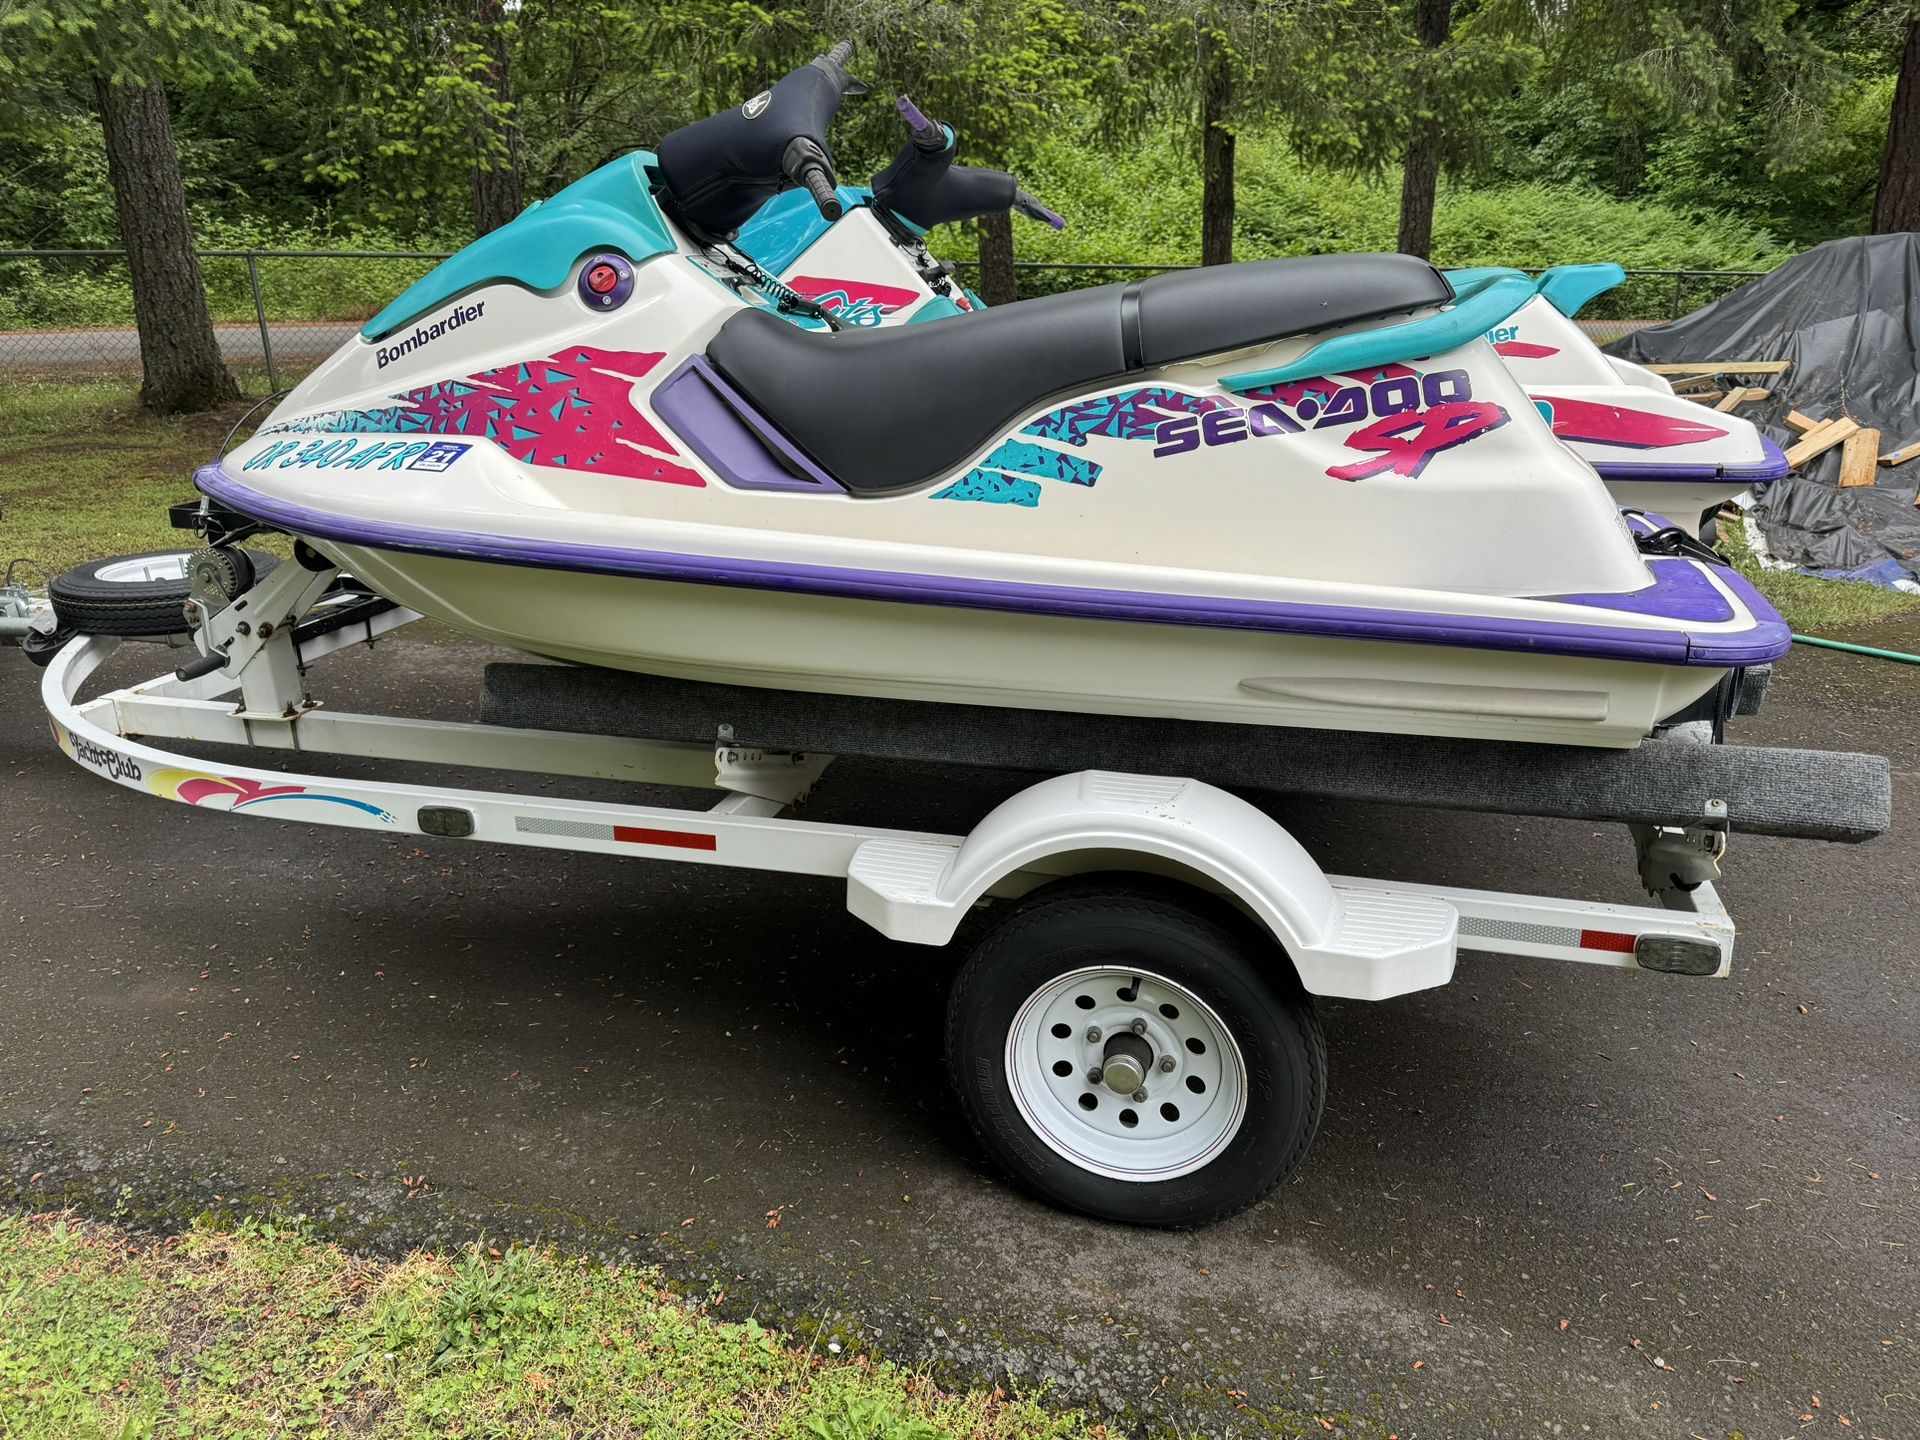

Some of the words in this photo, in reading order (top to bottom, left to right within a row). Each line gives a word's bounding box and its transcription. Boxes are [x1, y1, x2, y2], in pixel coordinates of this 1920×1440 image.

[376, 301, 485, 369] Bombardier
[242, 440, 300, 471] OR
[332, 441, 430, 471] AFR
[422, 450, 457, 463] 21
